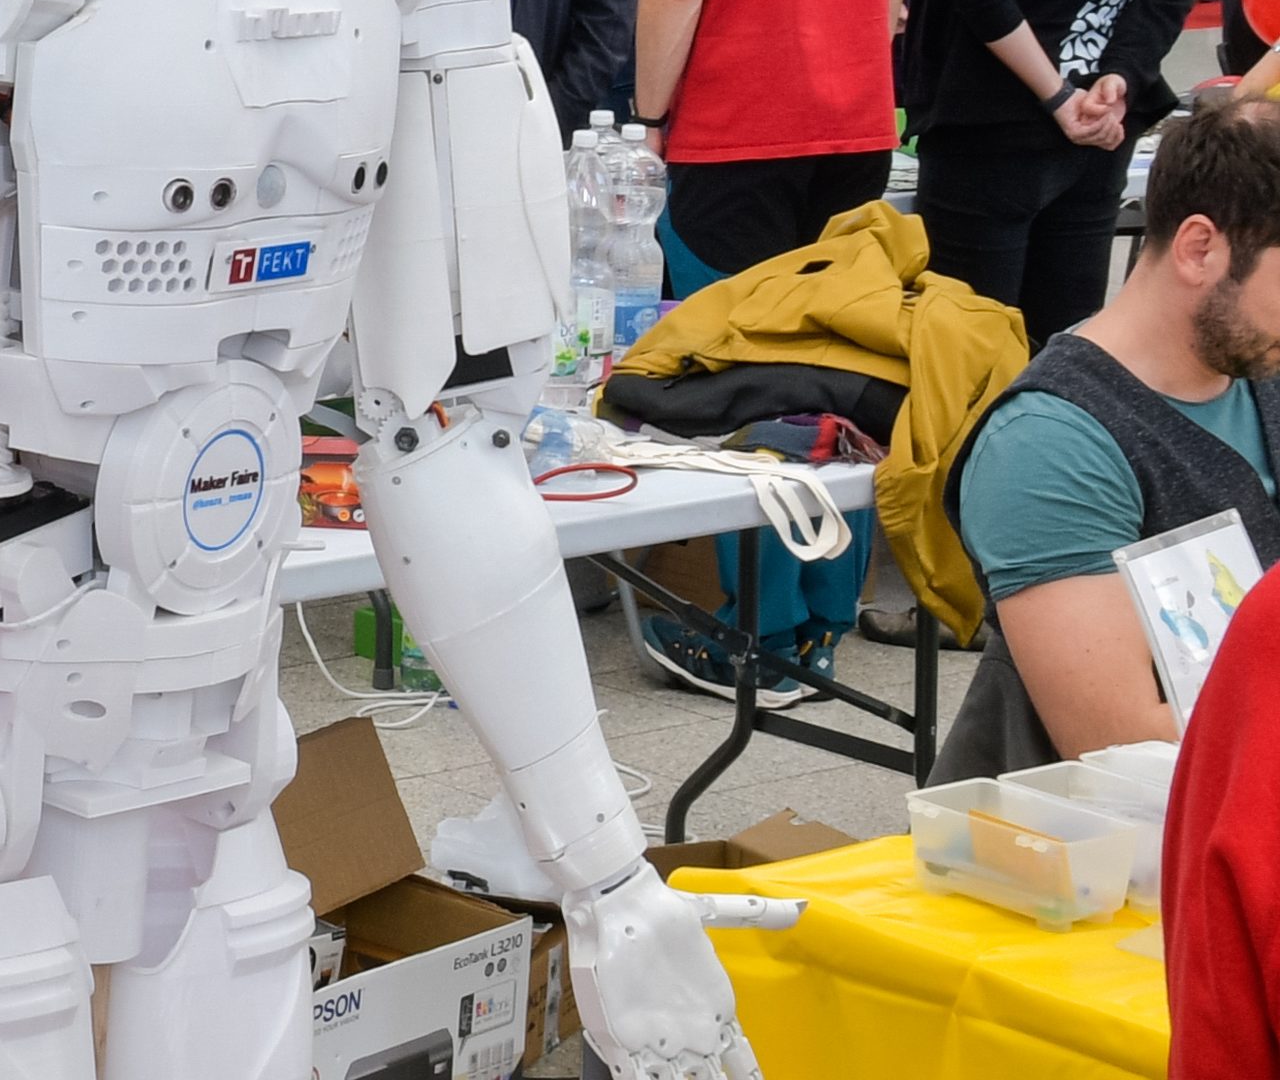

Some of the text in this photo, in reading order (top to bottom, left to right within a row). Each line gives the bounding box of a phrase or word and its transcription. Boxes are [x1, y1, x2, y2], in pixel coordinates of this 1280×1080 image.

[261, 248, 306, 274] FEKT
[190, 468, 259, 494] Maker Faire
[453, 933, 523, 971] EcoTank L3210
[313, 988, 362, 1023] PSON
